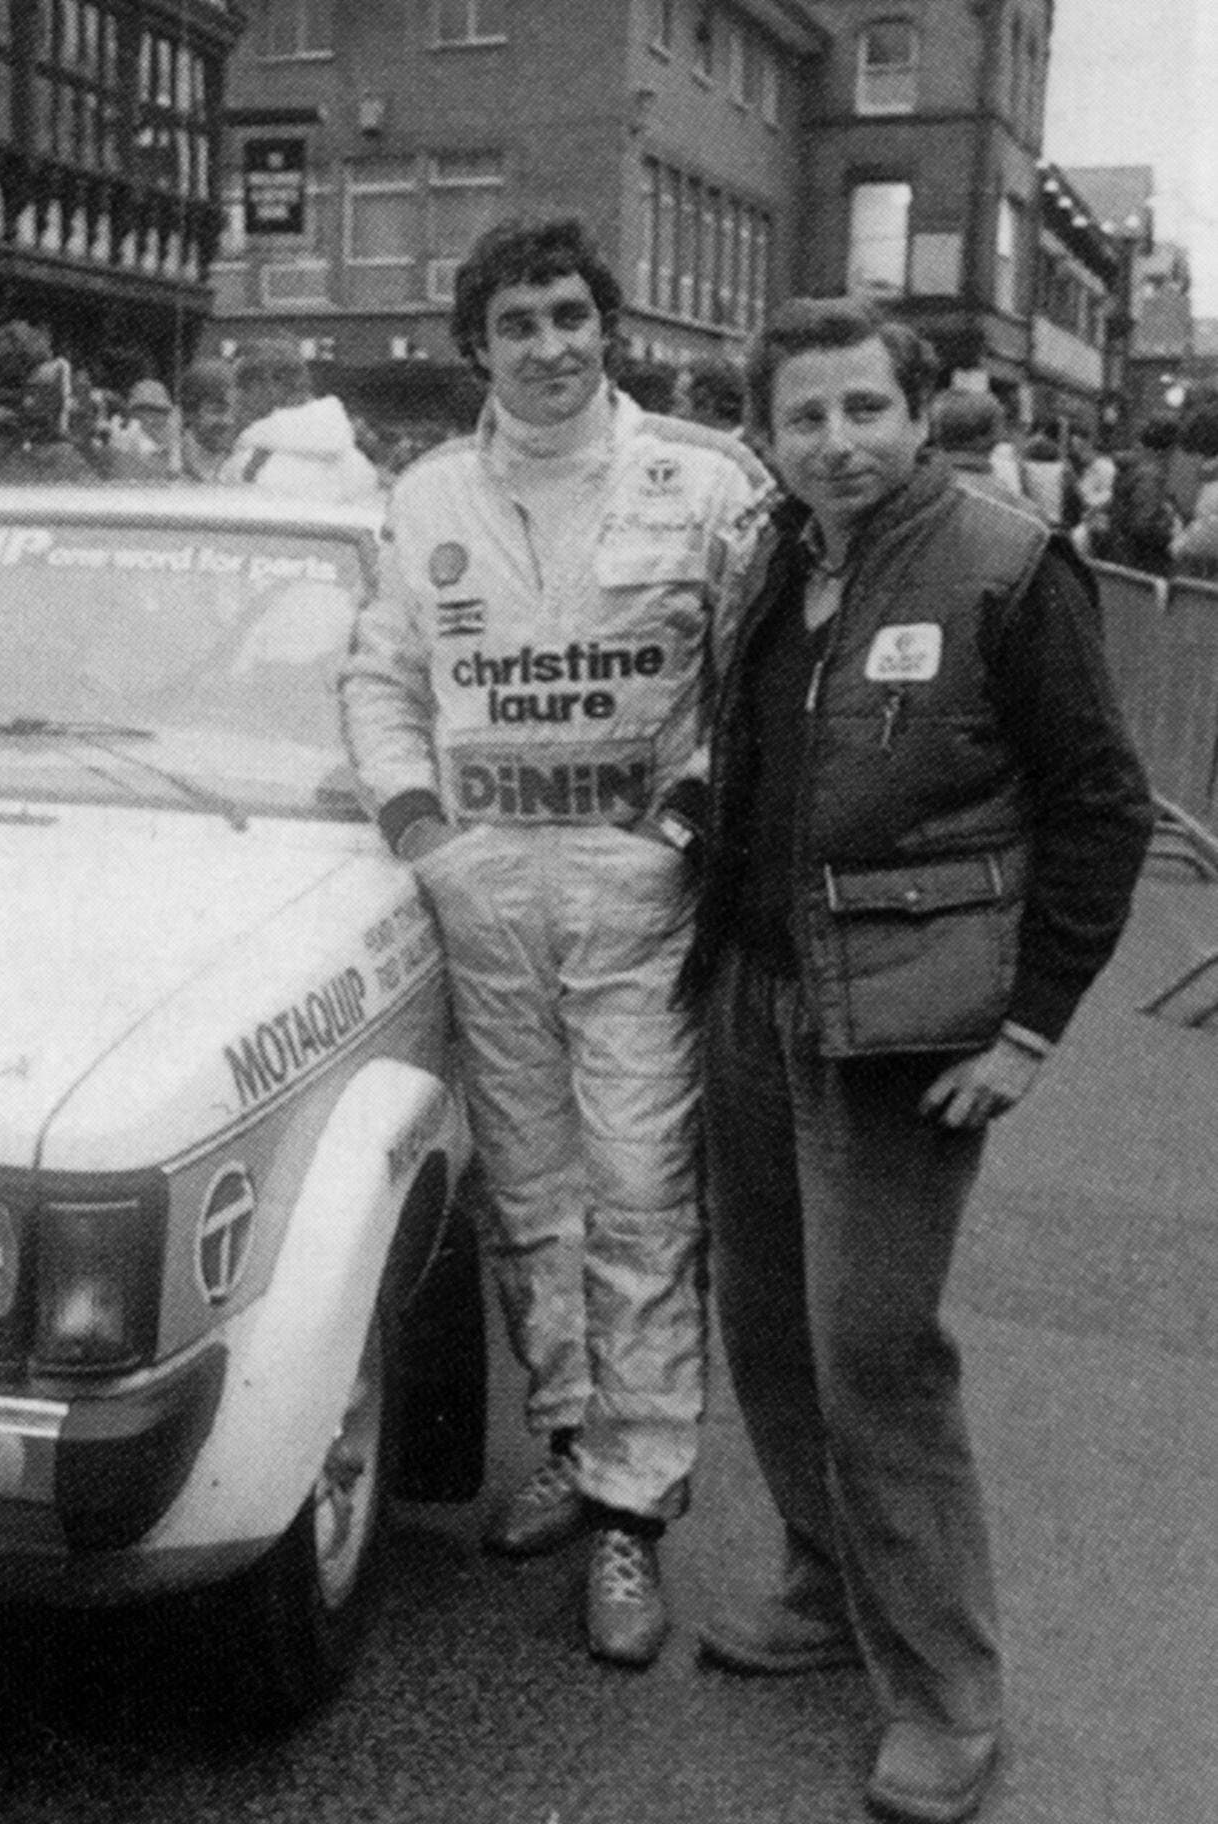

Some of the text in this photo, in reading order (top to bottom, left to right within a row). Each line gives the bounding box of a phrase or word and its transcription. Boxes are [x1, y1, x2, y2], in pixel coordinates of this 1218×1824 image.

[452, 642, 665, 690] christine
[489, 689, 617, 725] laure
[222, 965, 367, 1107] MOTAQUIP
